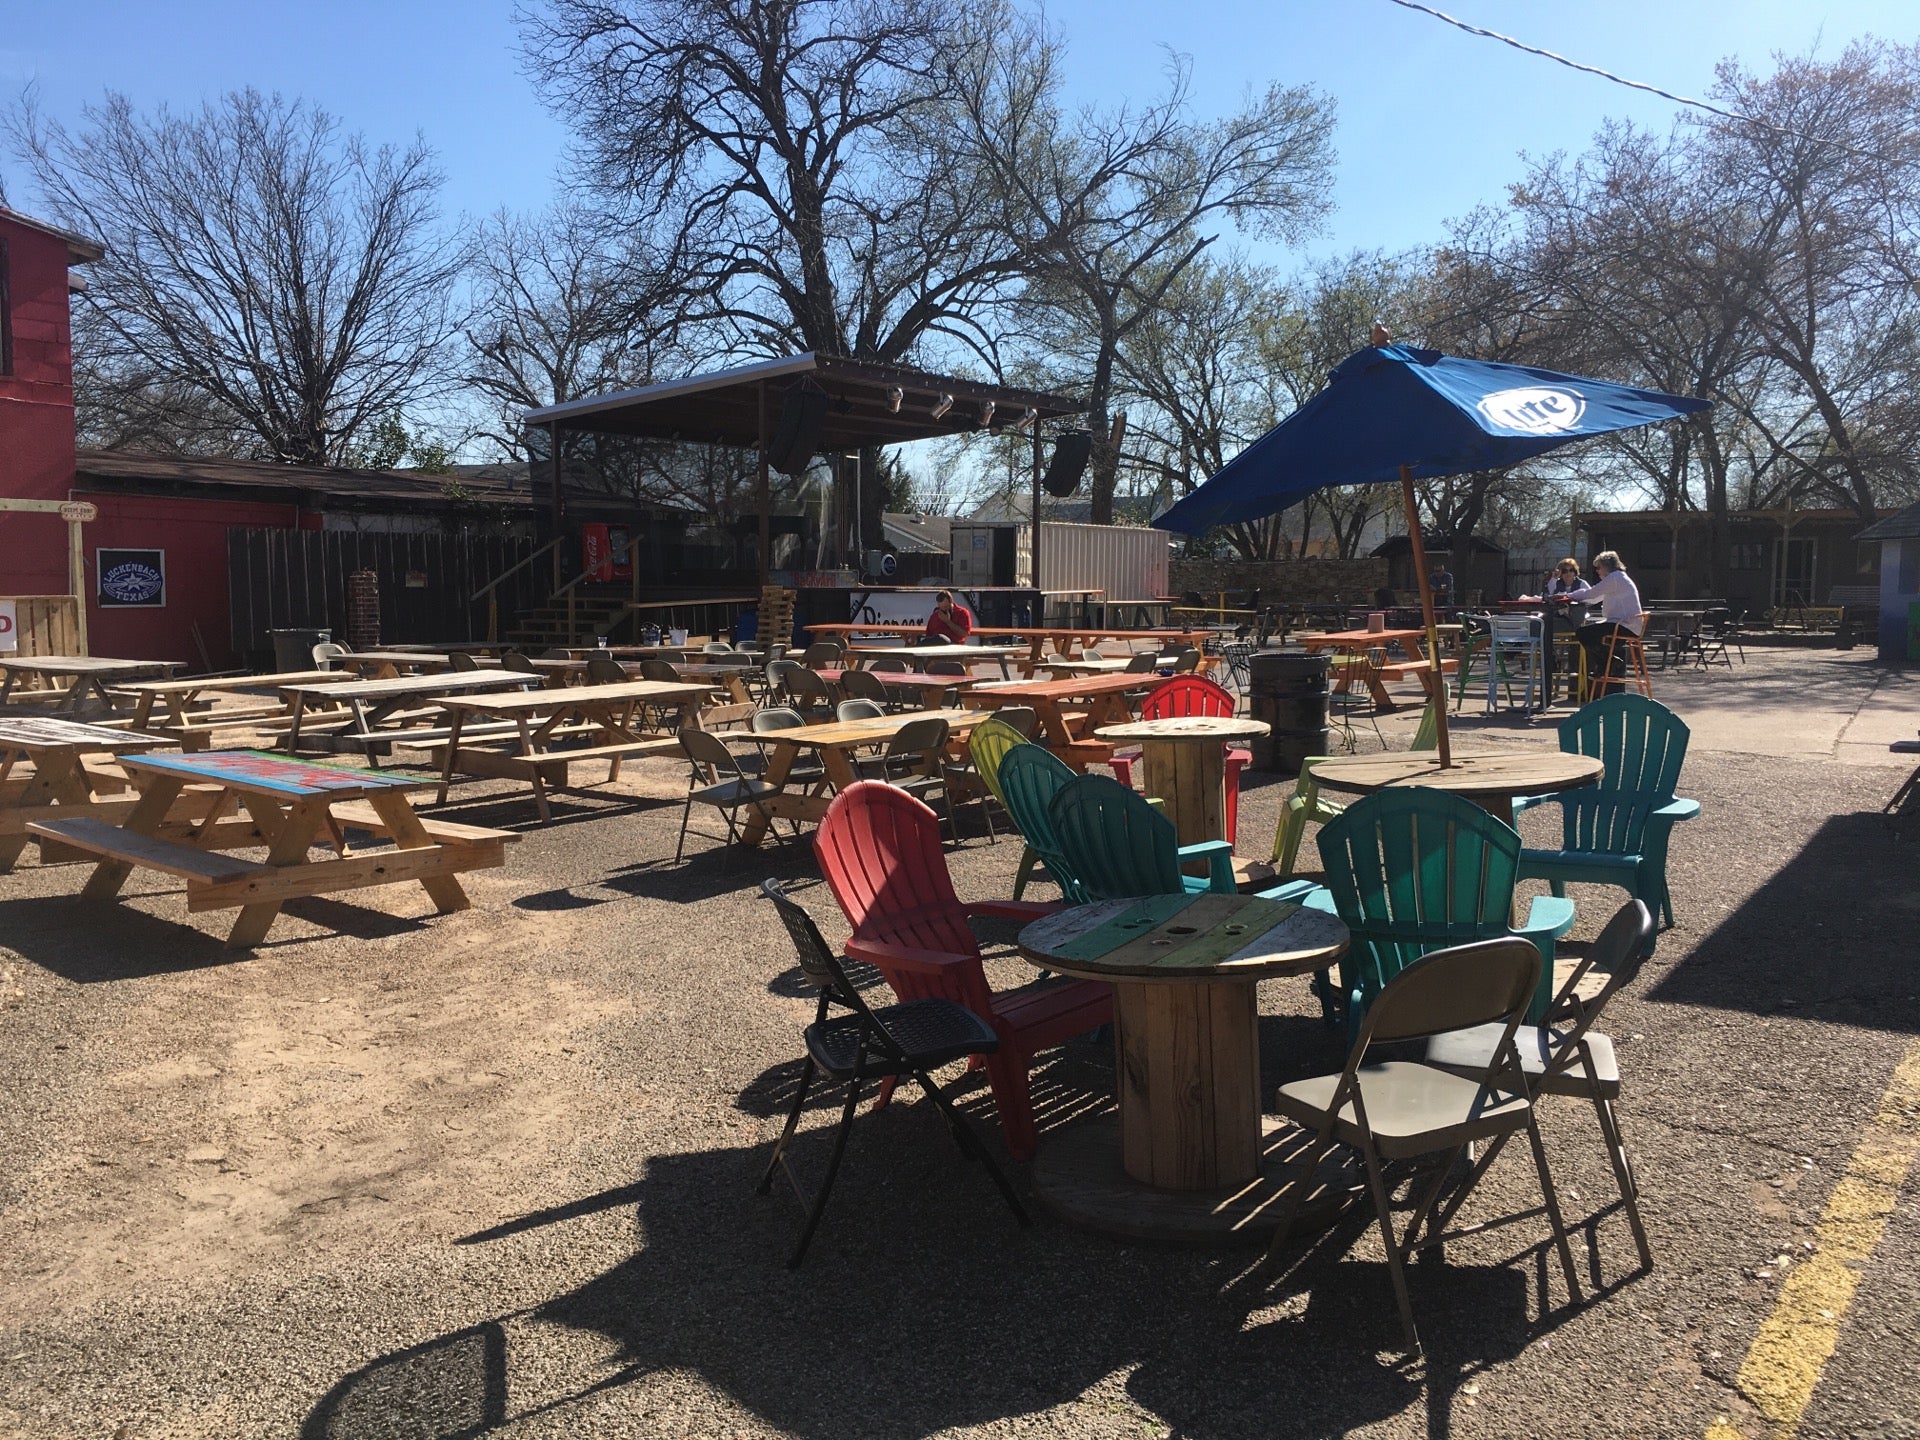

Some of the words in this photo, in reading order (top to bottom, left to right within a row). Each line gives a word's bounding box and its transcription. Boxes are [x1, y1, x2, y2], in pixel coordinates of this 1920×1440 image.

[1503, 396, 1567, 428] Lite
[586, 534, 598, 576] Cca-Cola
[103, 563, 160, 583] LUCKENBACH
[115, 590, 150, 602] TEXAS
